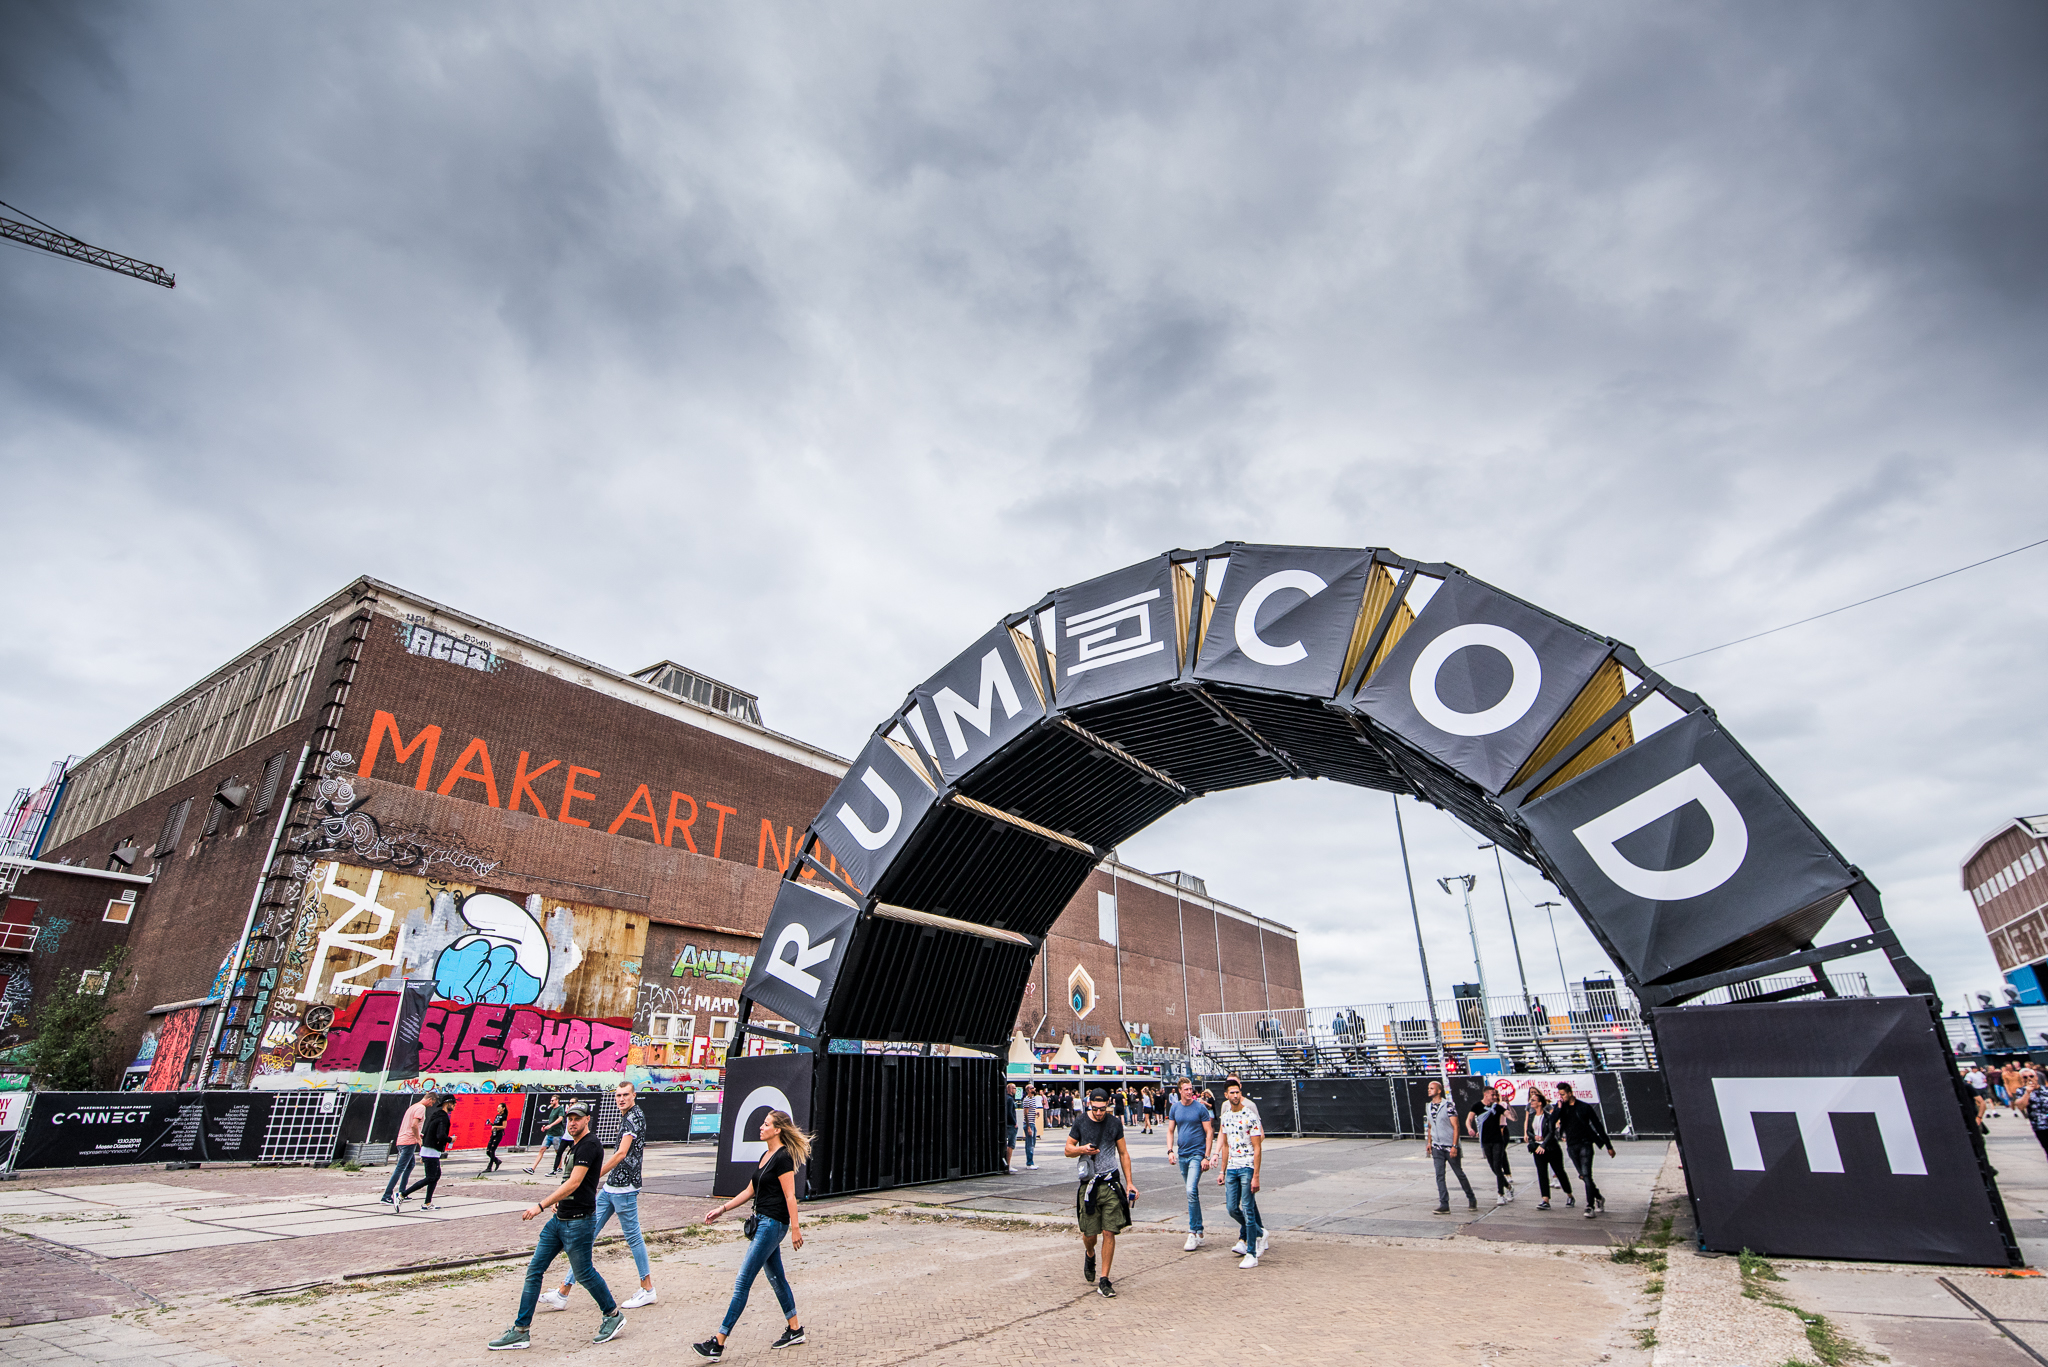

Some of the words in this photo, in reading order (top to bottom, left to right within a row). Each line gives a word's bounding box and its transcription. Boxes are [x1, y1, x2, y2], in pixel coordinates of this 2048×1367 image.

[357, 709, 601, 827] MAKE
[608, 784, 737, 858] ART
[51, 1111, 150, 1125] CONNECT
